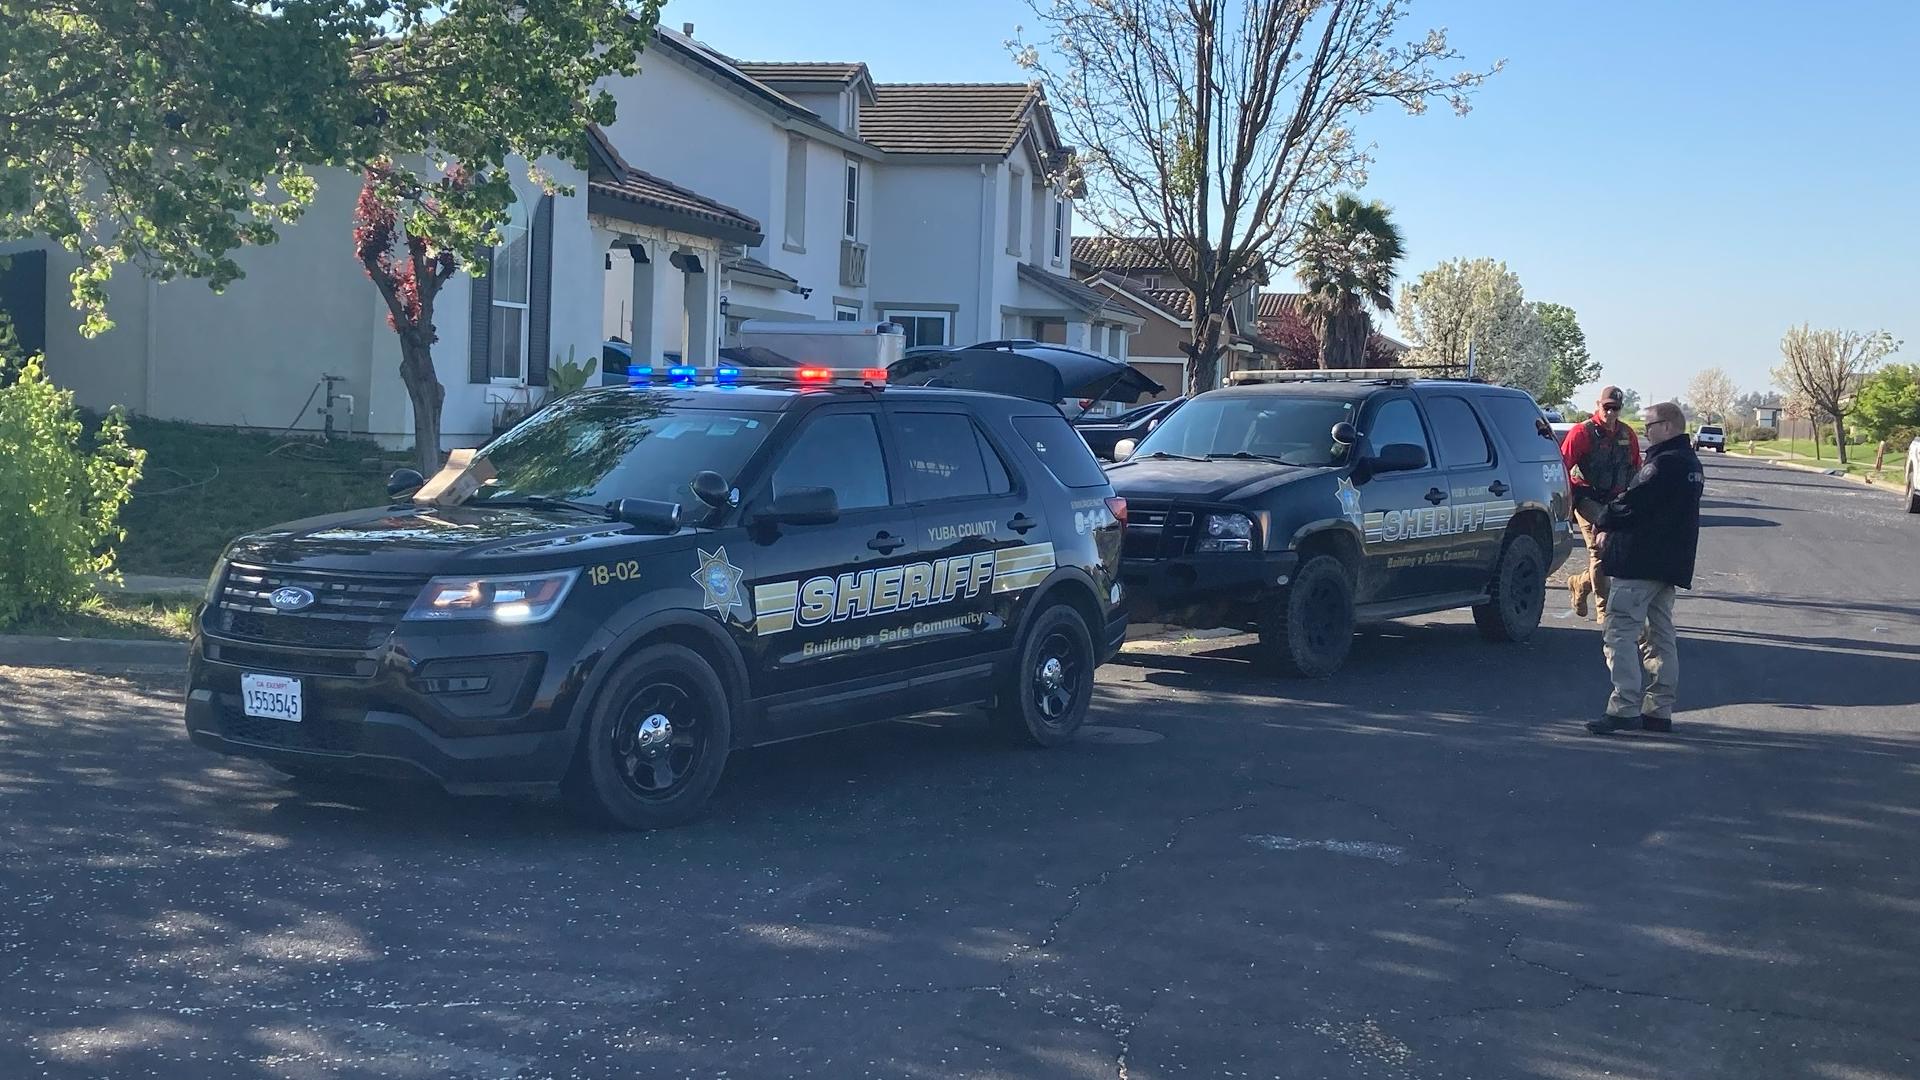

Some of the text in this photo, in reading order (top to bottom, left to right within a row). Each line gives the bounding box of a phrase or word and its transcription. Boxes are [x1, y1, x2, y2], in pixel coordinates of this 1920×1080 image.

[928, 519, 997, 542] YUBA COUNTY
[1382, 503, 1485, 543] SHERIFF
[588, 560, 641, 586] 18-02
[275, 589, 302, 605] Ford
[796, 550, 995, 627] SHERIFF
[803, 611, 984, 656] Building a Safe Community
[248, 690, 298, 715] 1553545
